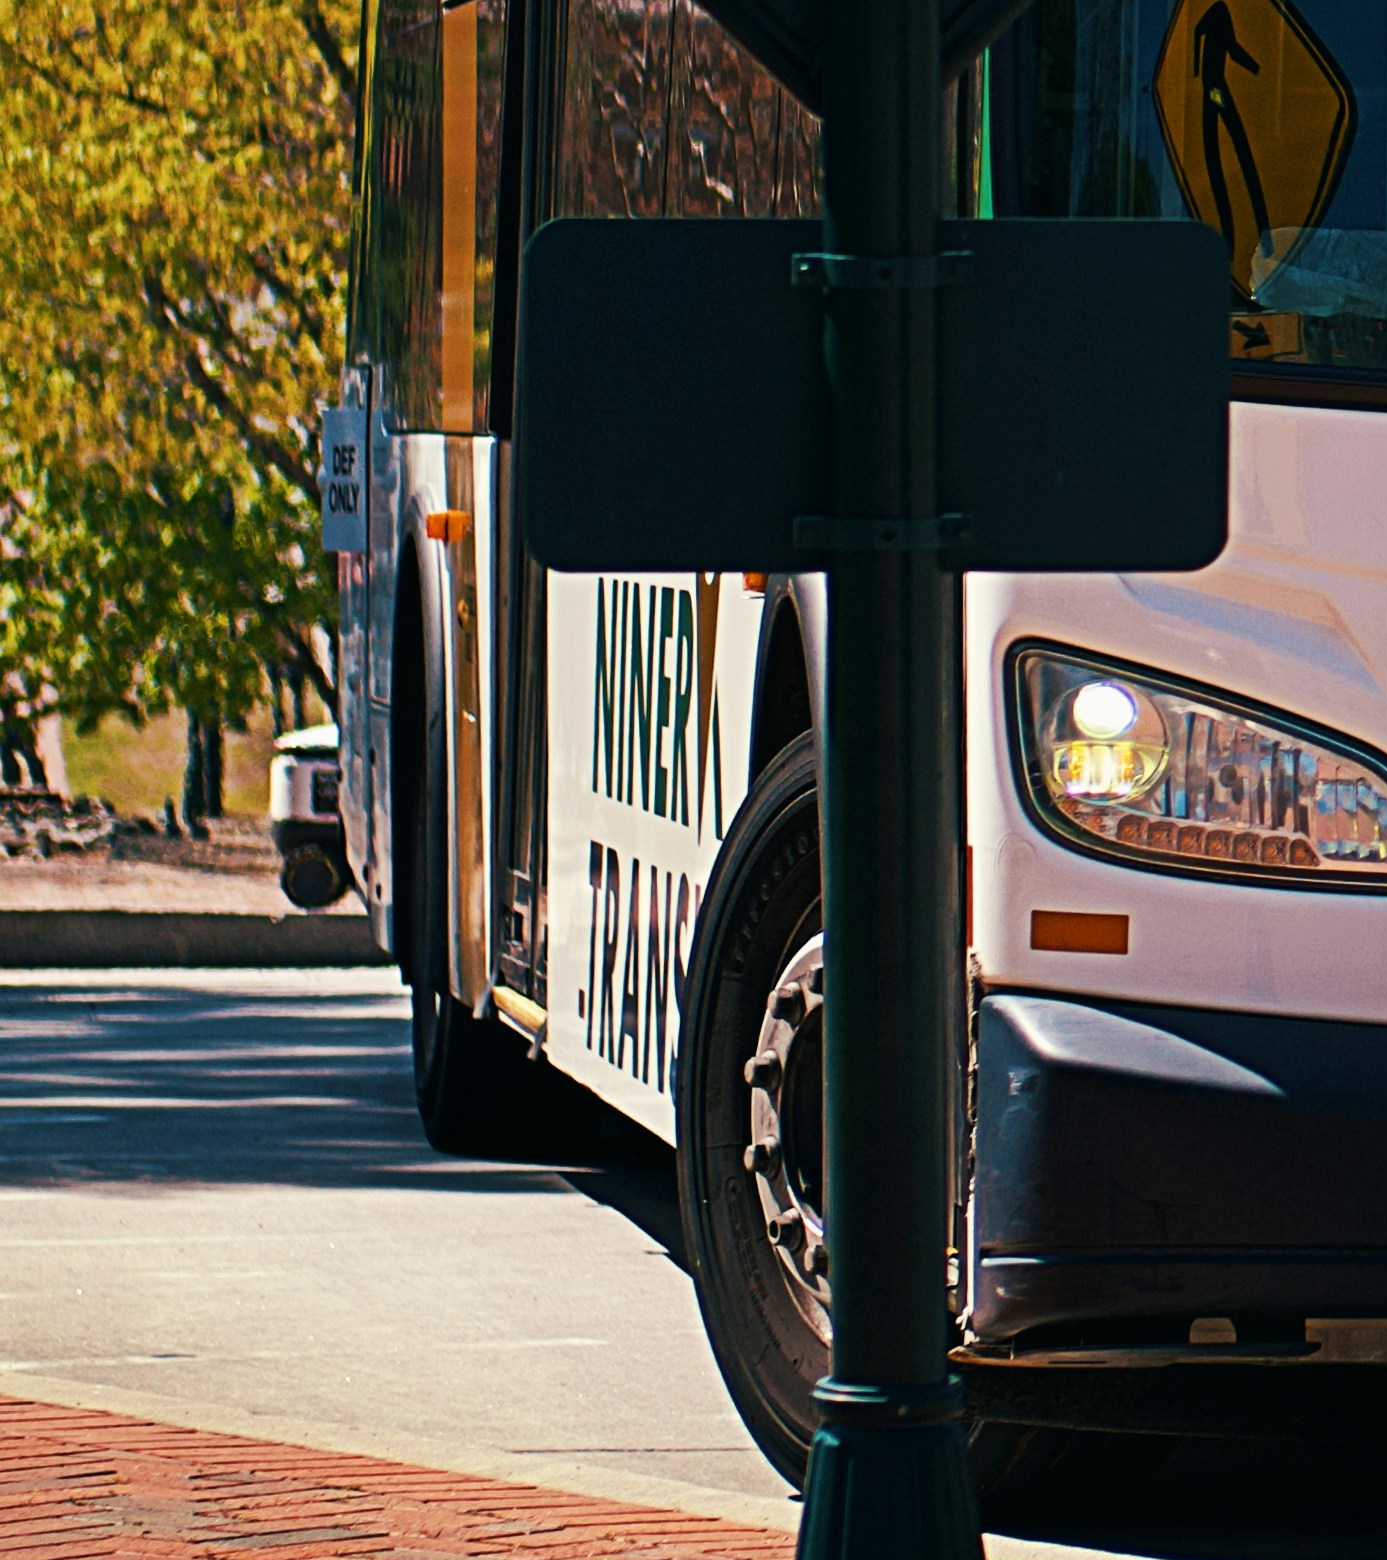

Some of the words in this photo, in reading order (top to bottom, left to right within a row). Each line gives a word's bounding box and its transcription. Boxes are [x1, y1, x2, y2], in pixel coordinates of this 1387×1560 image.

[328, 481, 360, 515] ONLY
[332, 443, 356, 477] DEF
[592, 576, 694, 827] NINER
[586, 839, 701, 1106] TRANS
